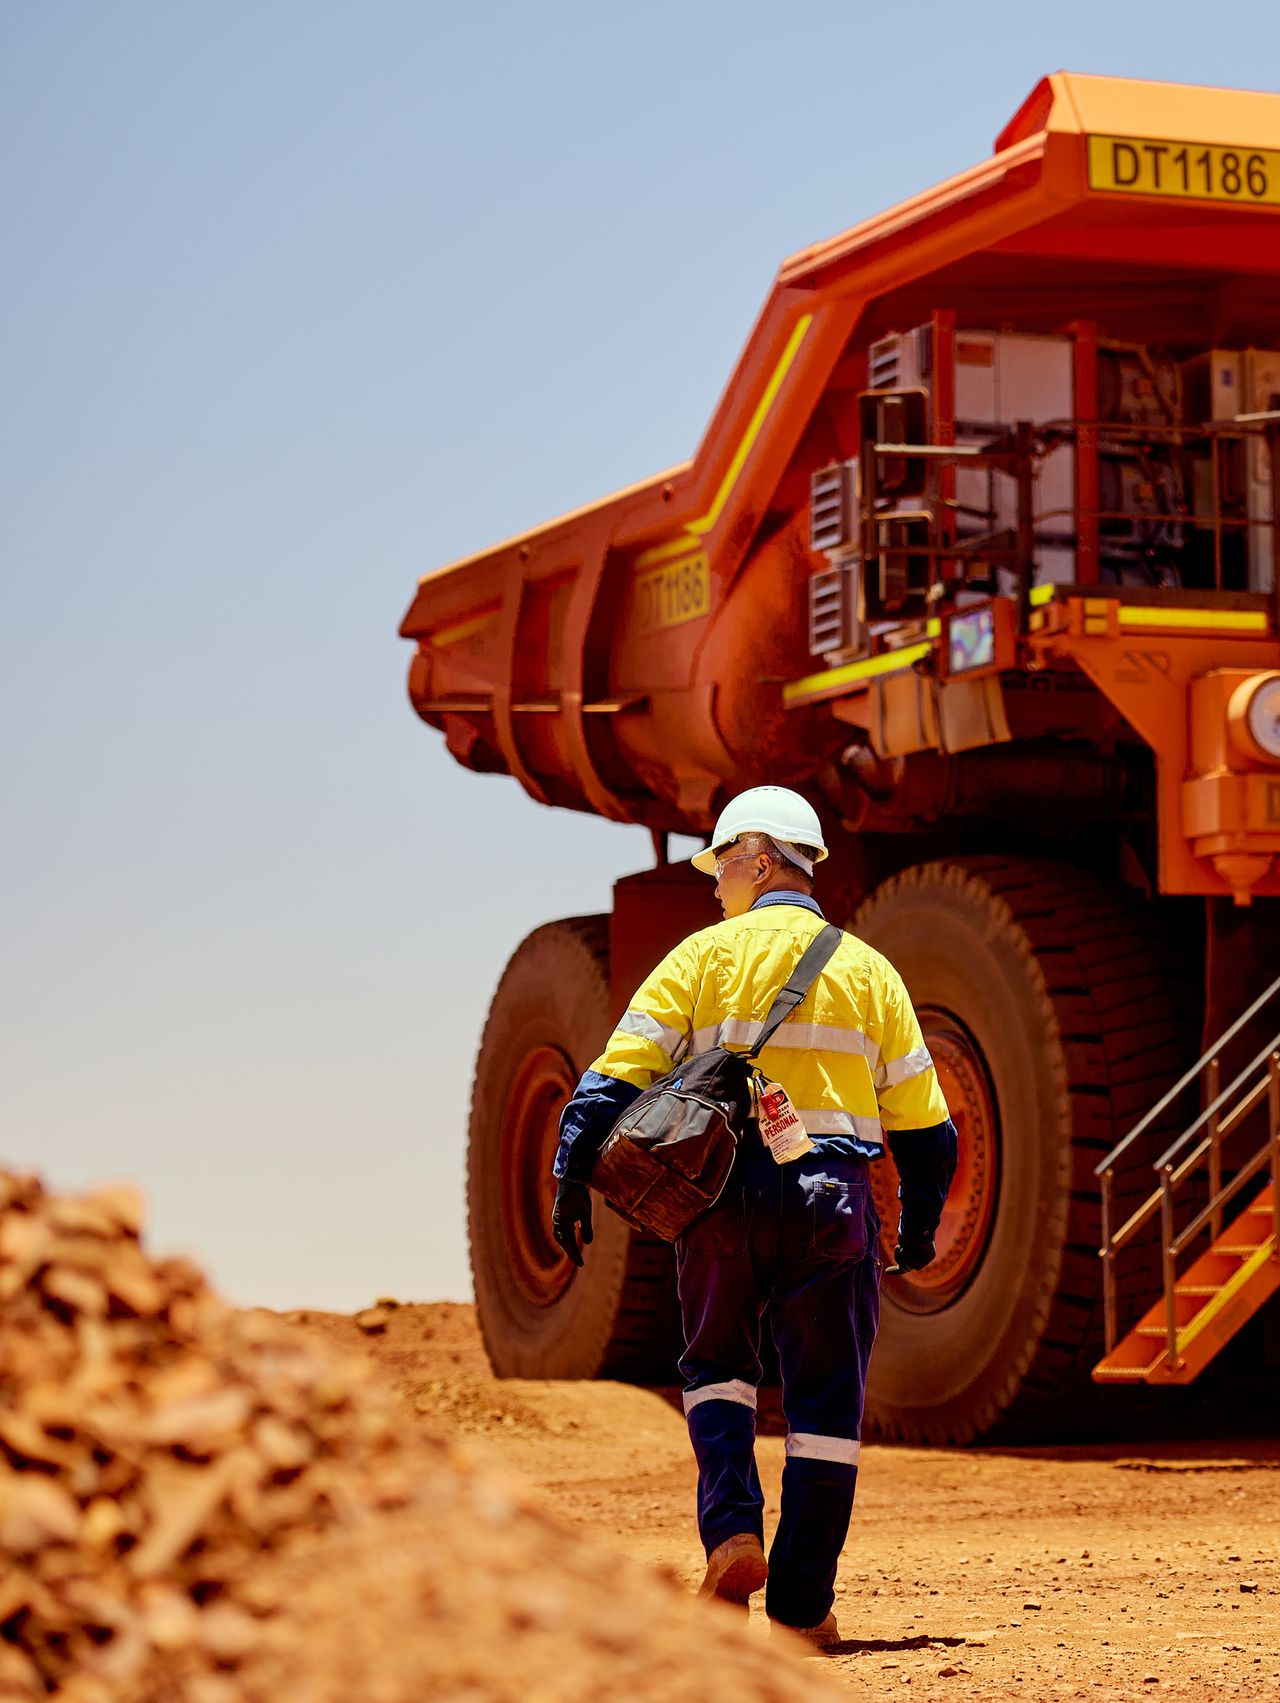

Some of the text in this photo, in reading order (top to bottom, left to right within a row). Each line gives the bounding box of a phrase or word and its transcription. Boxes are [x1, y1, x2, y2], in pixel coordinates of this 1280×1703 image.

[1112, 142, 1268, 197] DT1186
[640, 560, 703, 625] DT1186
[763, 1113, 799, 1139] PERSONAL
